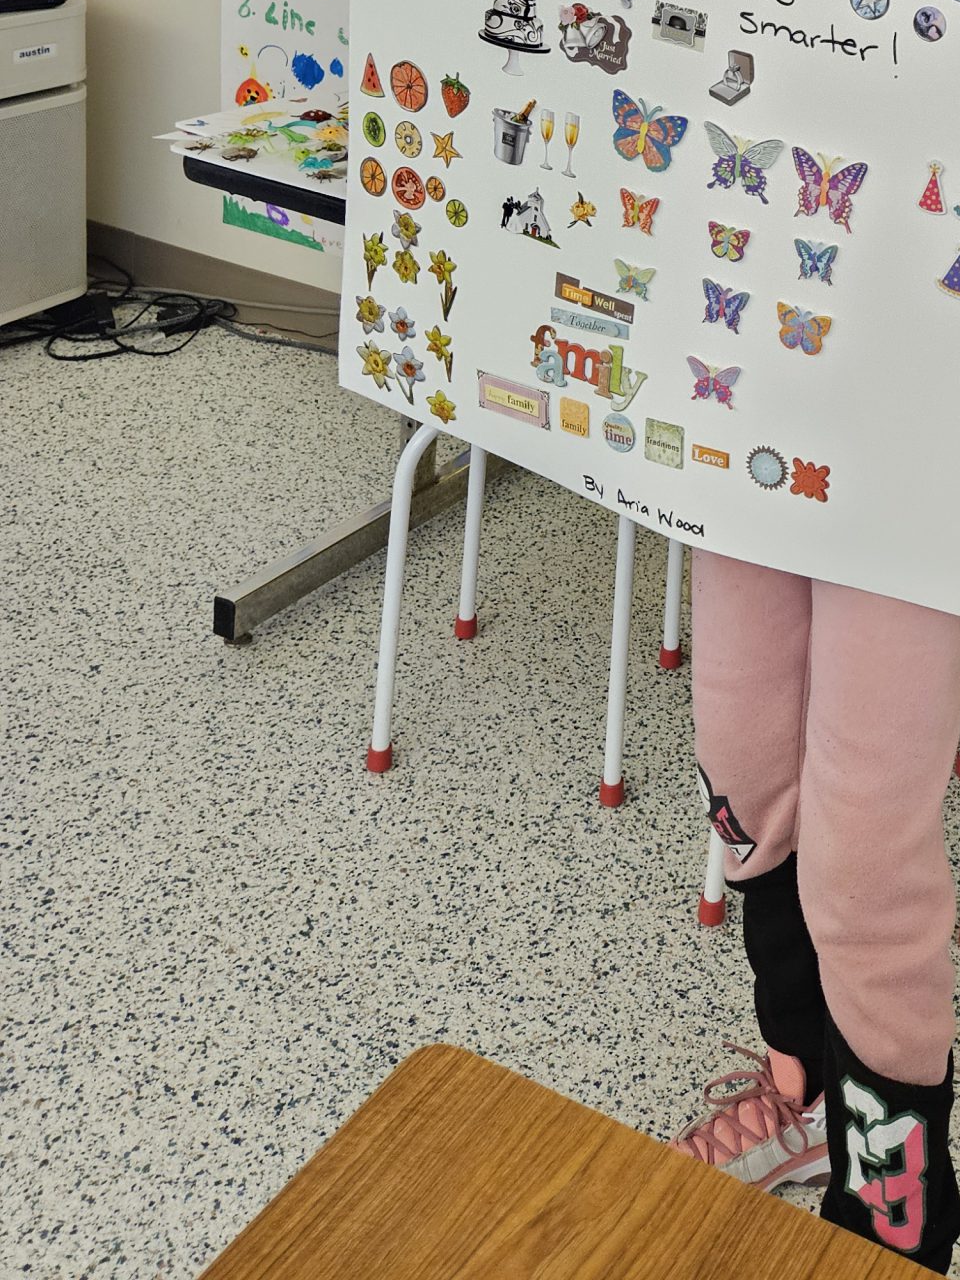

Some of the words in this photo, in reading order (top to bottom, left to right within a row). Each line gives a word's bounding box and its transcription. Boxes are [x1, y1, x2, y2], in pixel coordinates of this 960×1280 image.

[19, 46, 50, 58] austin
[600, 41, 616, 52] Just
[589, 48, 622, 64] Married
[564, 287, 591, 304] Time
[594, 295, 615, 311] Well
[614, 311, 631, 321] spent
[570, 314, 605, 332] Together
[530, 324, 648, 412] family
[507, 395, 534, 412] family
[562, 419, 586, 436] family
[605, 429, 632, 446] time
[646, 437, 679, 452] Traditions
[694, 448, 723, 466] Love
[583, 475, 603, 498] By
[618, 488, 649, 516] Aria
[658, 509, 704, 537] Wood
